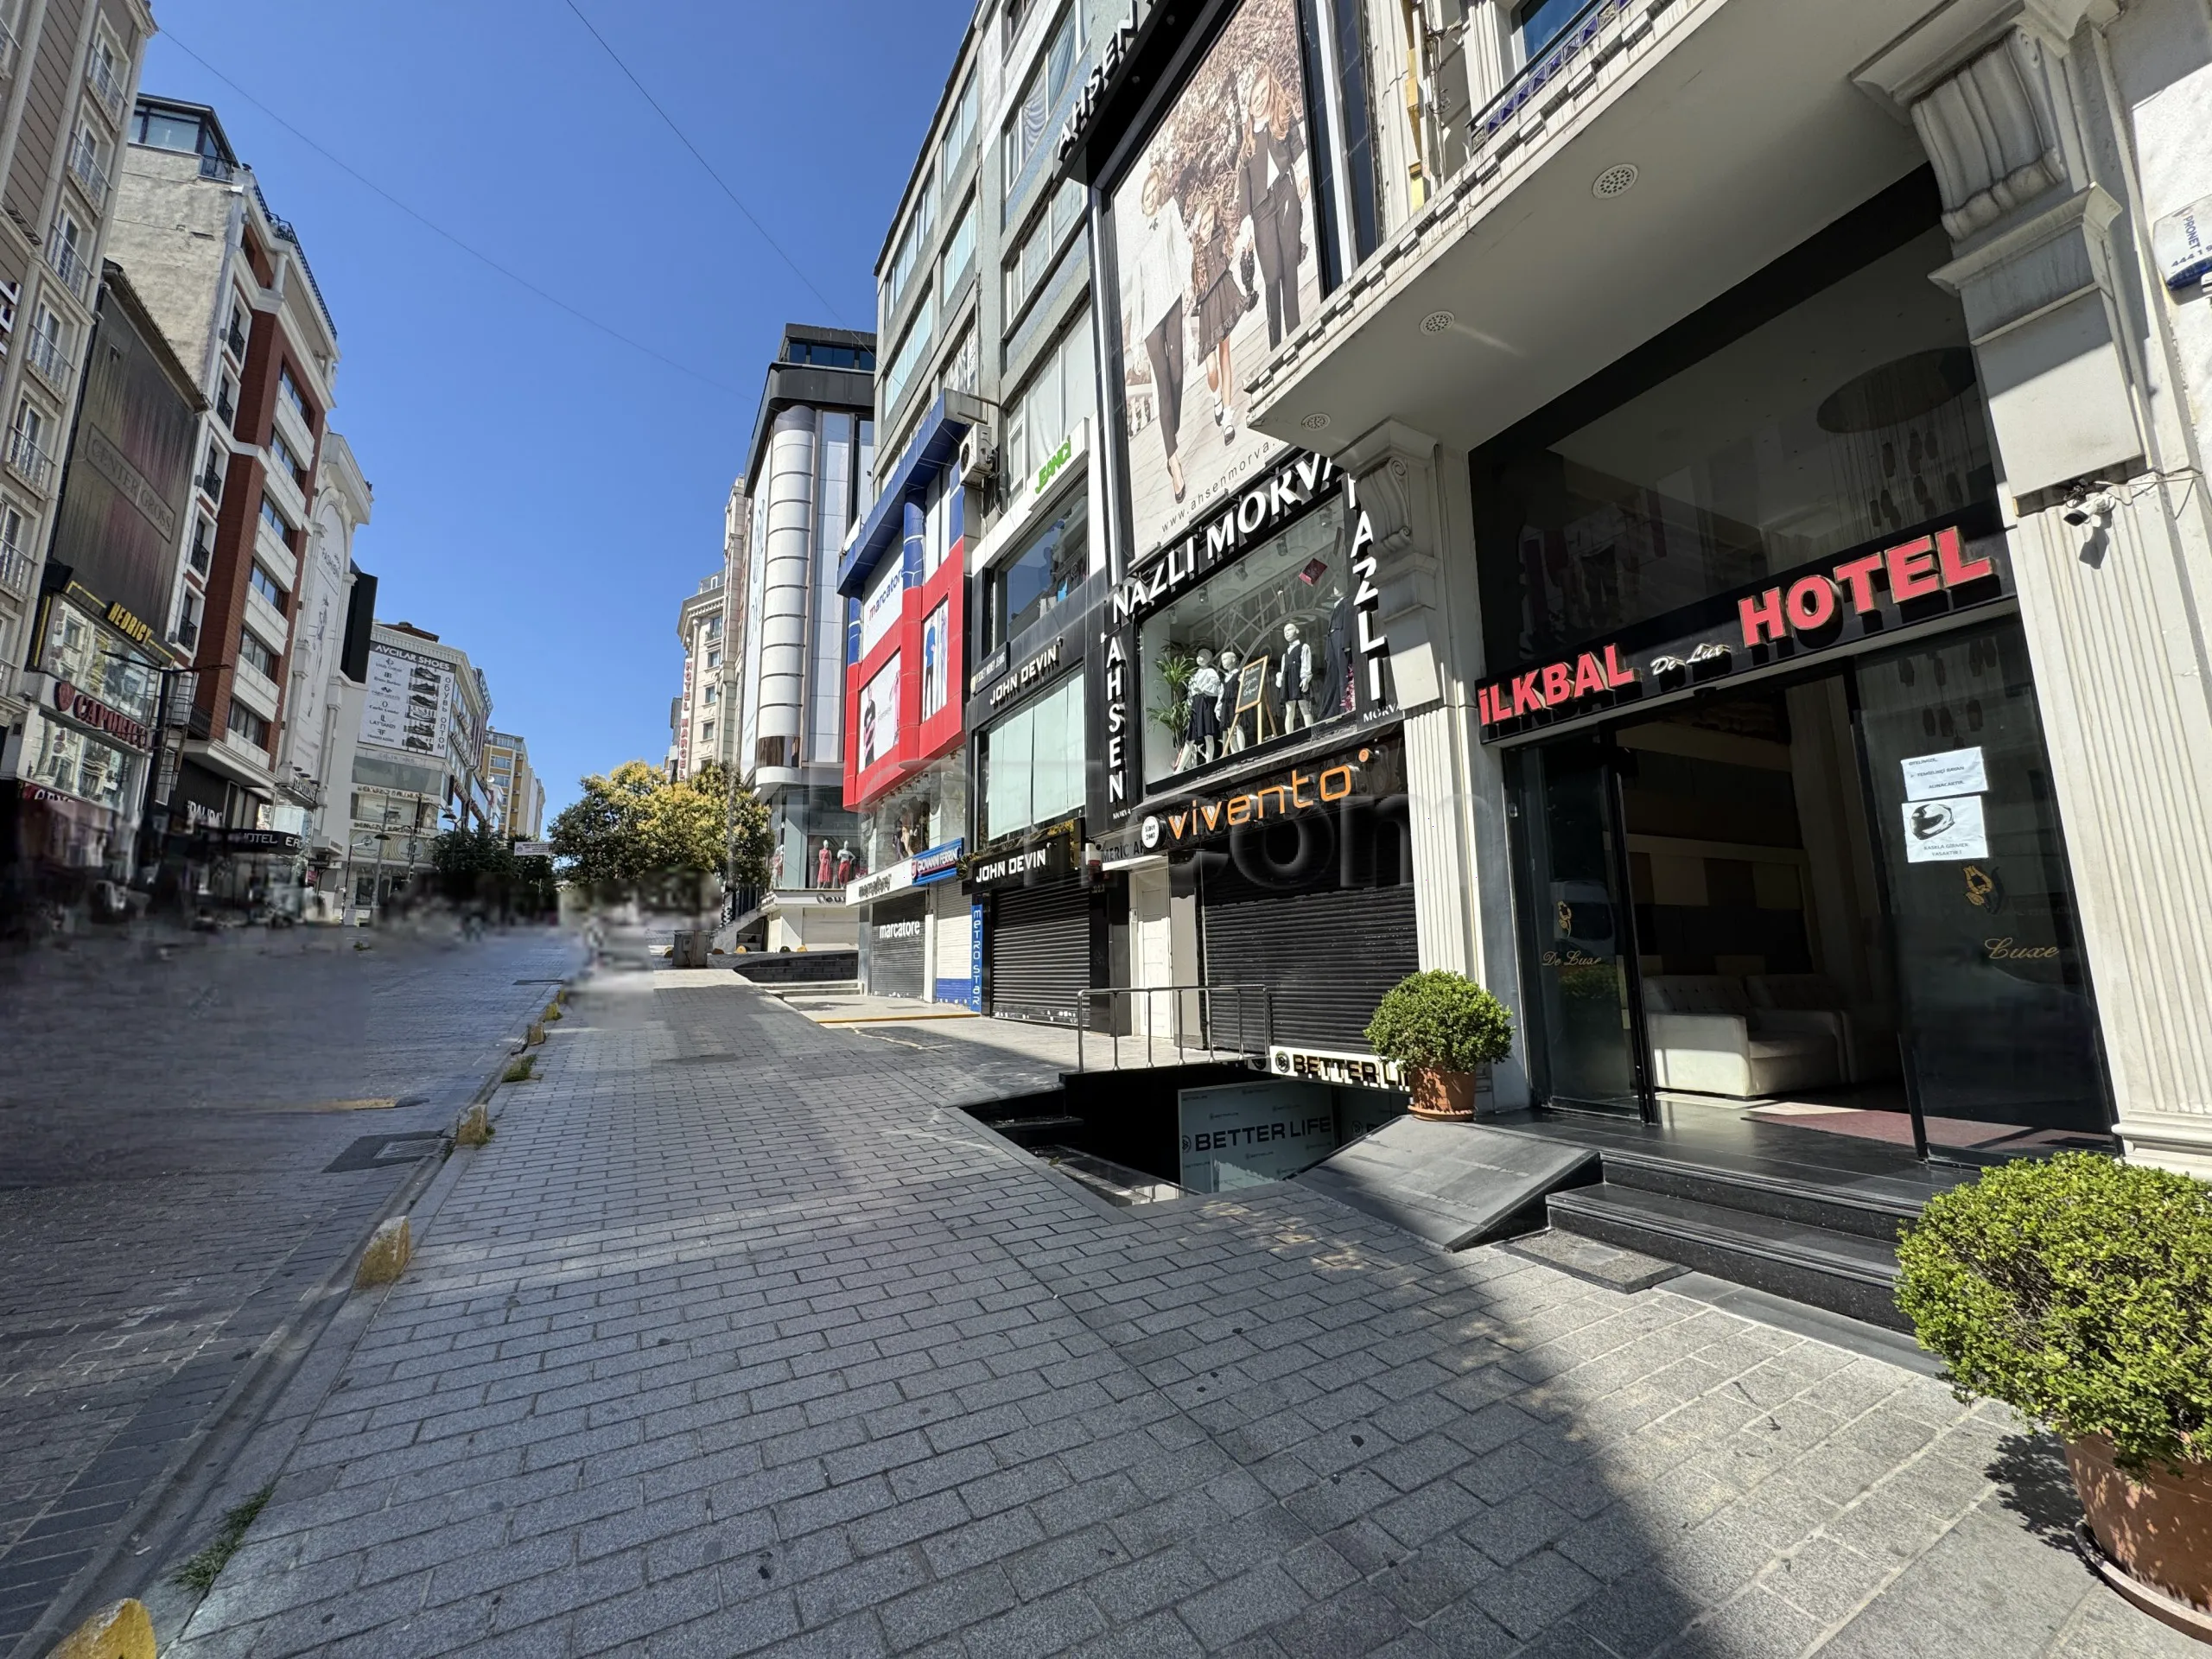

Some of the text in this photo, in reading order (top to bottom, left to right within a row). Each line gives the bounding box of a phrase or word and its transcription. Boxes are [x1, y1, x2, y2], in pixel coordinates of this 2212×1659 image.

[2183, 215, 2202, 249] PRONET
[2171, 254, 2195, 267] 444
[92, 439, 171, 531] CENTER GROSS
[1161, 439, 1282, 532] www.ahsenmorva.
[869, 567, 904, 620] marcator
[1113, 537, 1195, 624] NAZLI
[1738, 526, 1994, 648] HOTEL
[376, 645, 416, 661] AVCILAR
[418, 656, 450, 671] SHOES
[989, 645, 1058, 706] JOHN DEVIN
[683, 662, 692, 711] HOTEL
[437, 677, 451, 751] ОБУВЬ ОПТОМ
[1106, 635, 1125, 804] AHSEN
[1168, 765, 1352, 840] vivento
[976, 849, 1046, 883] JOHN DEVIN
[879, 920, 920, 939] marcatore
[1294, 1054, 1377, 1084] BETTER
[1195, 1116, 1332, 1152] BETTER LIFE
